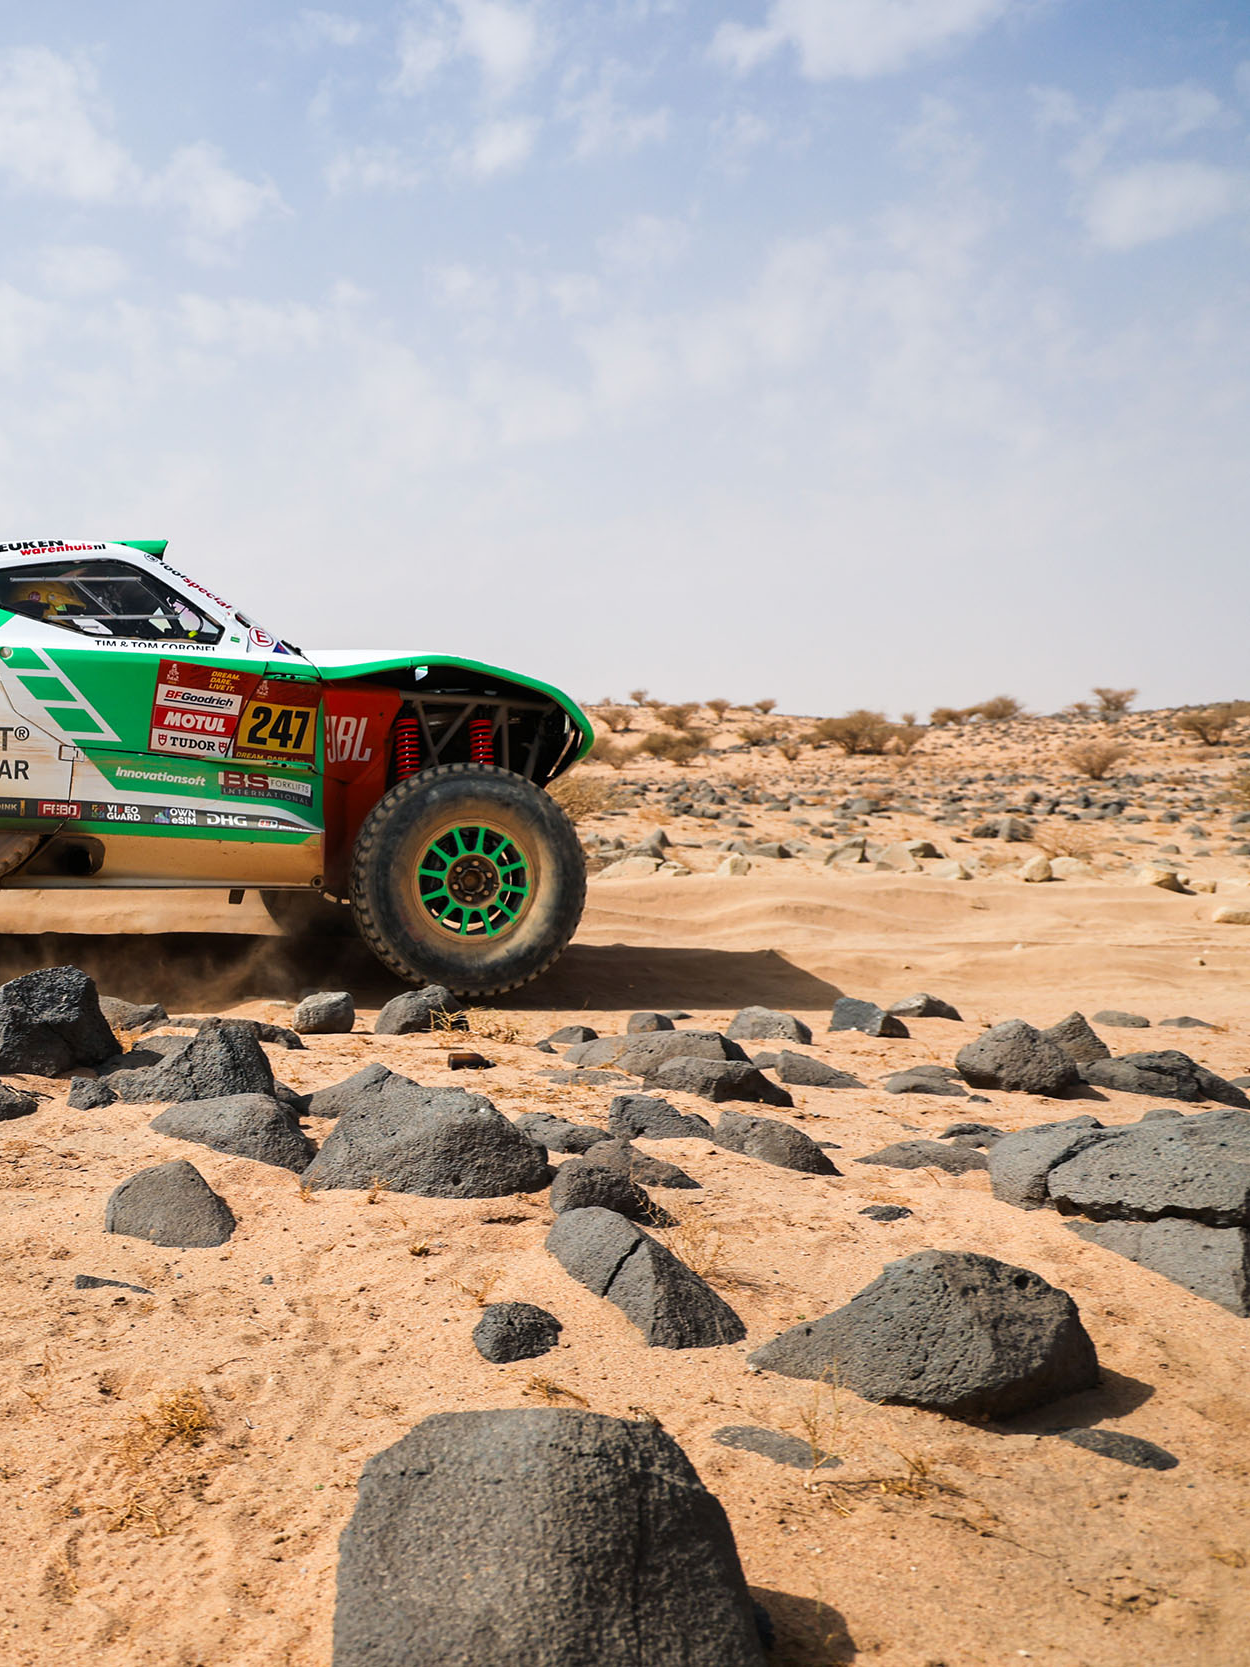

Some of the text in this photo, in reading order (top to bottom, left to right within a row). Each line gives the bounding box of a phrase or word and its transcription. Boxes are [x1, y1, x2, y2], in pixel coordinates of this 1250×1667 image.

[94, 639, 117, 647] TIM
[210, 677, 232, 686] DARE.
[211, 671, 240, 681] DREAM.
[209, 683, 226, 691] LIVE
[165, 689, 234, 707] BFGoodrich
[163, 711, 226, 733] MOTUL
[247, 705, 311, 749] 247
[170, 736, 216, 752] TUDOR
[325, 715, 372, 763] JBL
[115, 766, 206, 787] Innovationsoft
[270, 780, 309, 794] FORKLIFTS
[222, 787, 309, 805] INTERNATIONAL
[43, 803, 78, 816] FEBO
[169, 808, 196, 818] OWN
[106, 812, 141, 822] GUARD
[171, 816, 197, 826] eSIM
[206, 813, 248, 827] DHG
